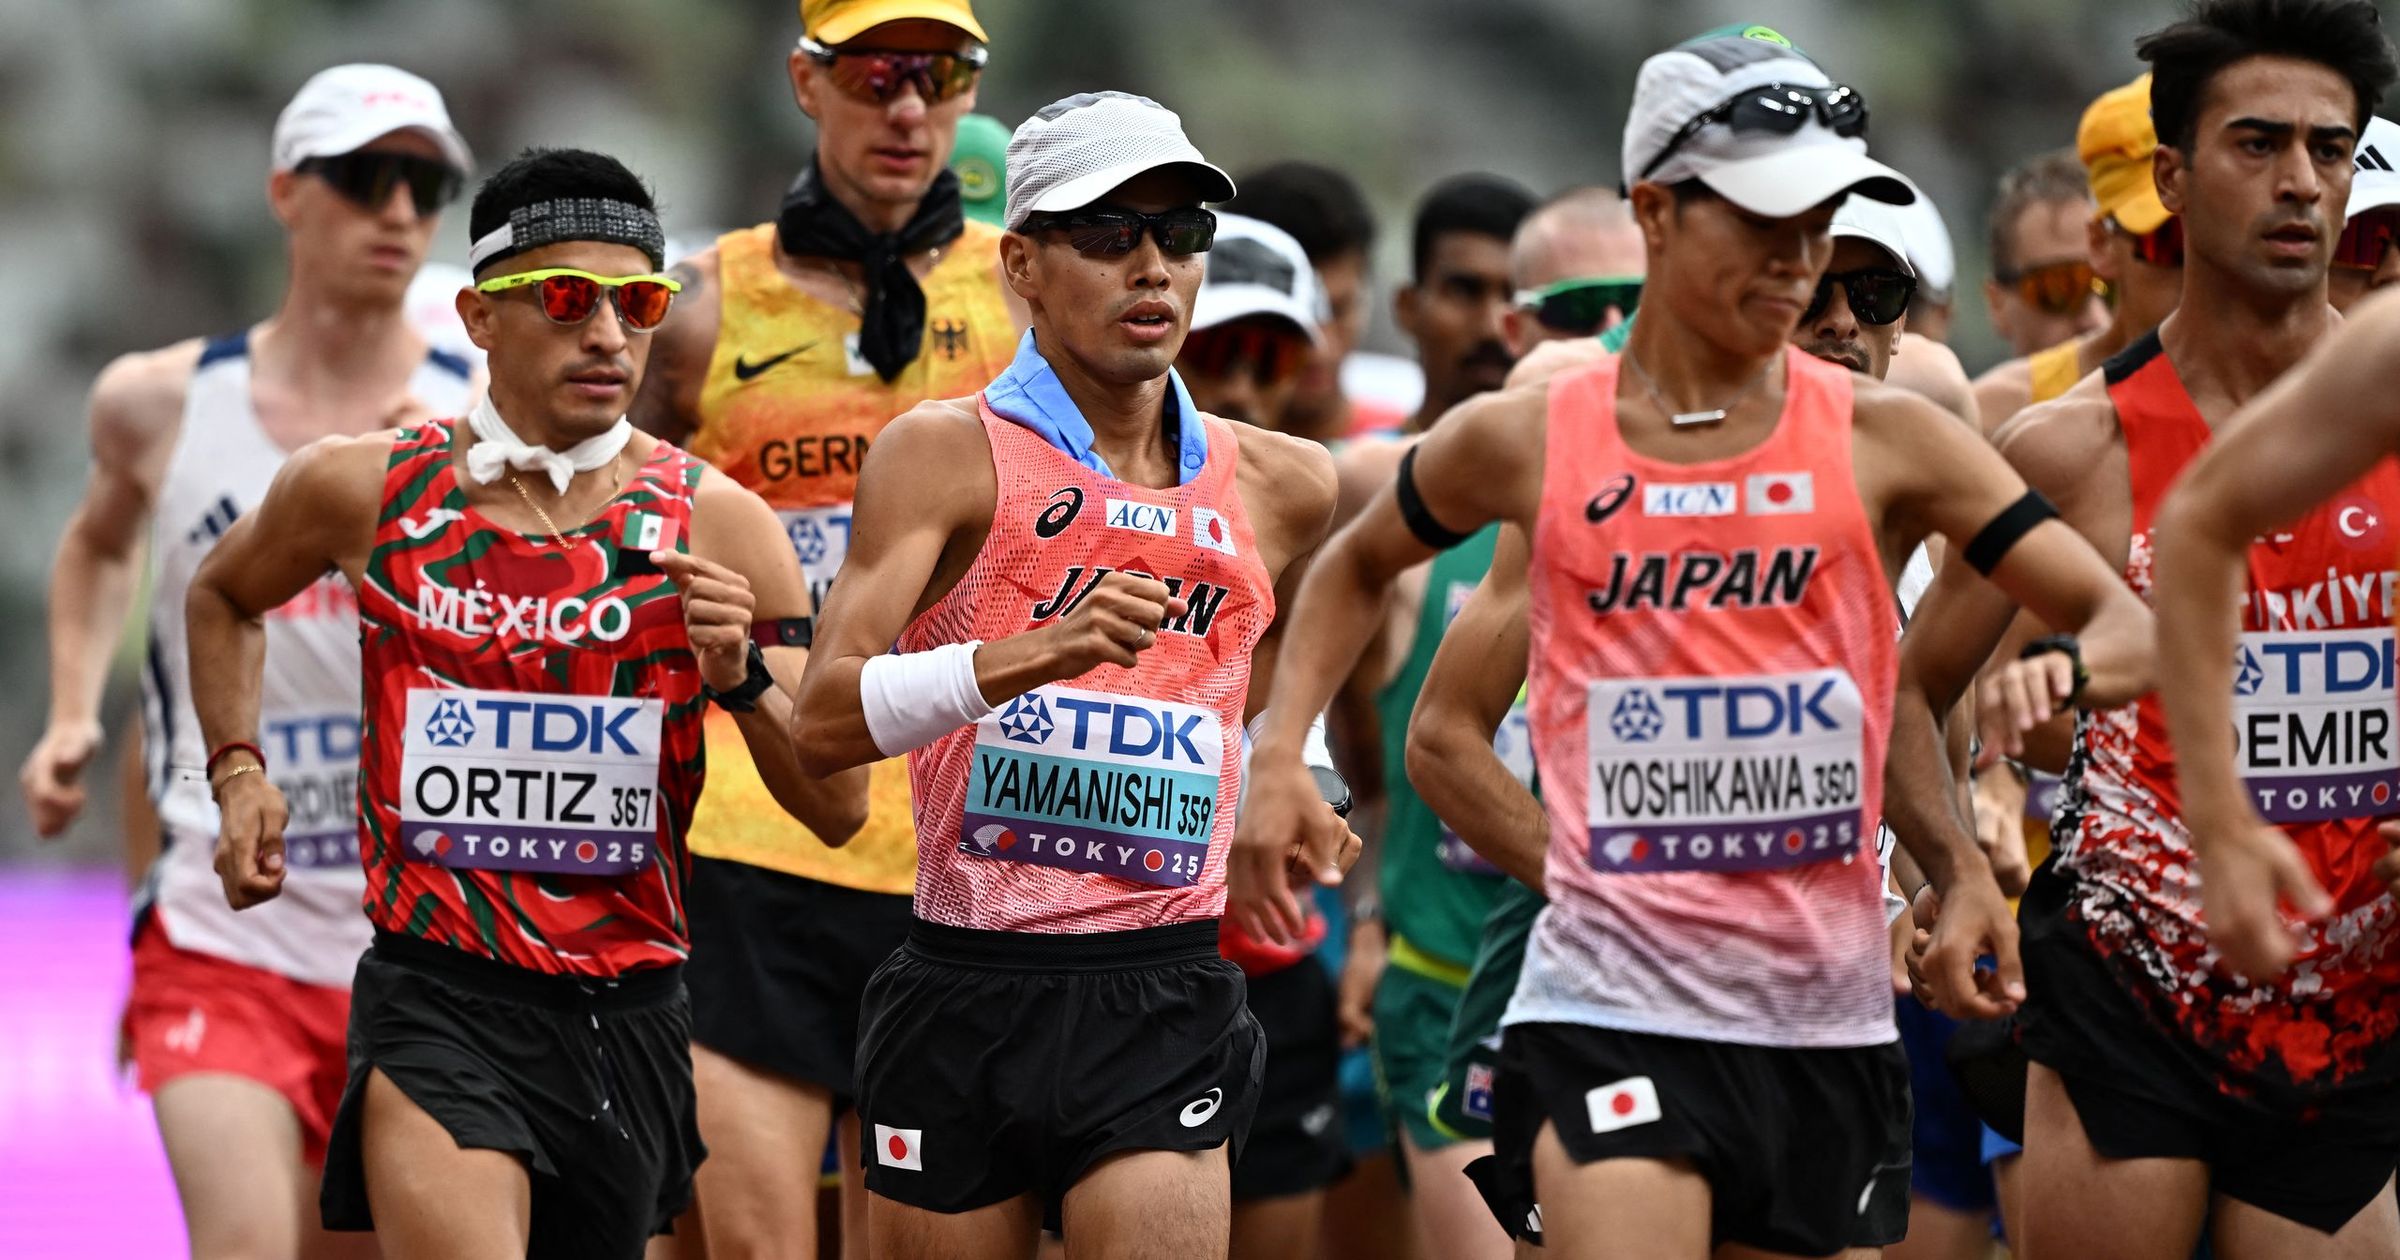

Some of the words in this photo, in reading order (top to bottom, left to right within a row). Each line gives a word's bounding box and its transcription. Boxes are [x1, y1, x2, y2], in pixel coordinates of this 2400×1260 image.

[1110, 502, 1175, 533] ACN
[1651, 485, 1731, 514] ACN
[417, 578, 632, 642] MÉXICO
[1587, 547, 1820, 614] JAPAN
[476, 700, 643, 756] TDK
[1056, 697, 1206, 765] TDK
[1663, 679, 1841, 739] TDK
[2231, 708, 2389, 768] EMIR
[415, 765, 597, 824] ORTIZ
[610, 787, 652, 828] 367
[982, 753, 1174, 831] YAMANISHI
[1176, 794, 1212, 838] 359
[1597, 755, 1807, 818] YOSHIKAWA
[1813, 761, 1857, 807] 360
[607, 843, 645, 863] 25
[1171, 852, 1199, 876] 25
[1812, 820, 1853, 850] 25
